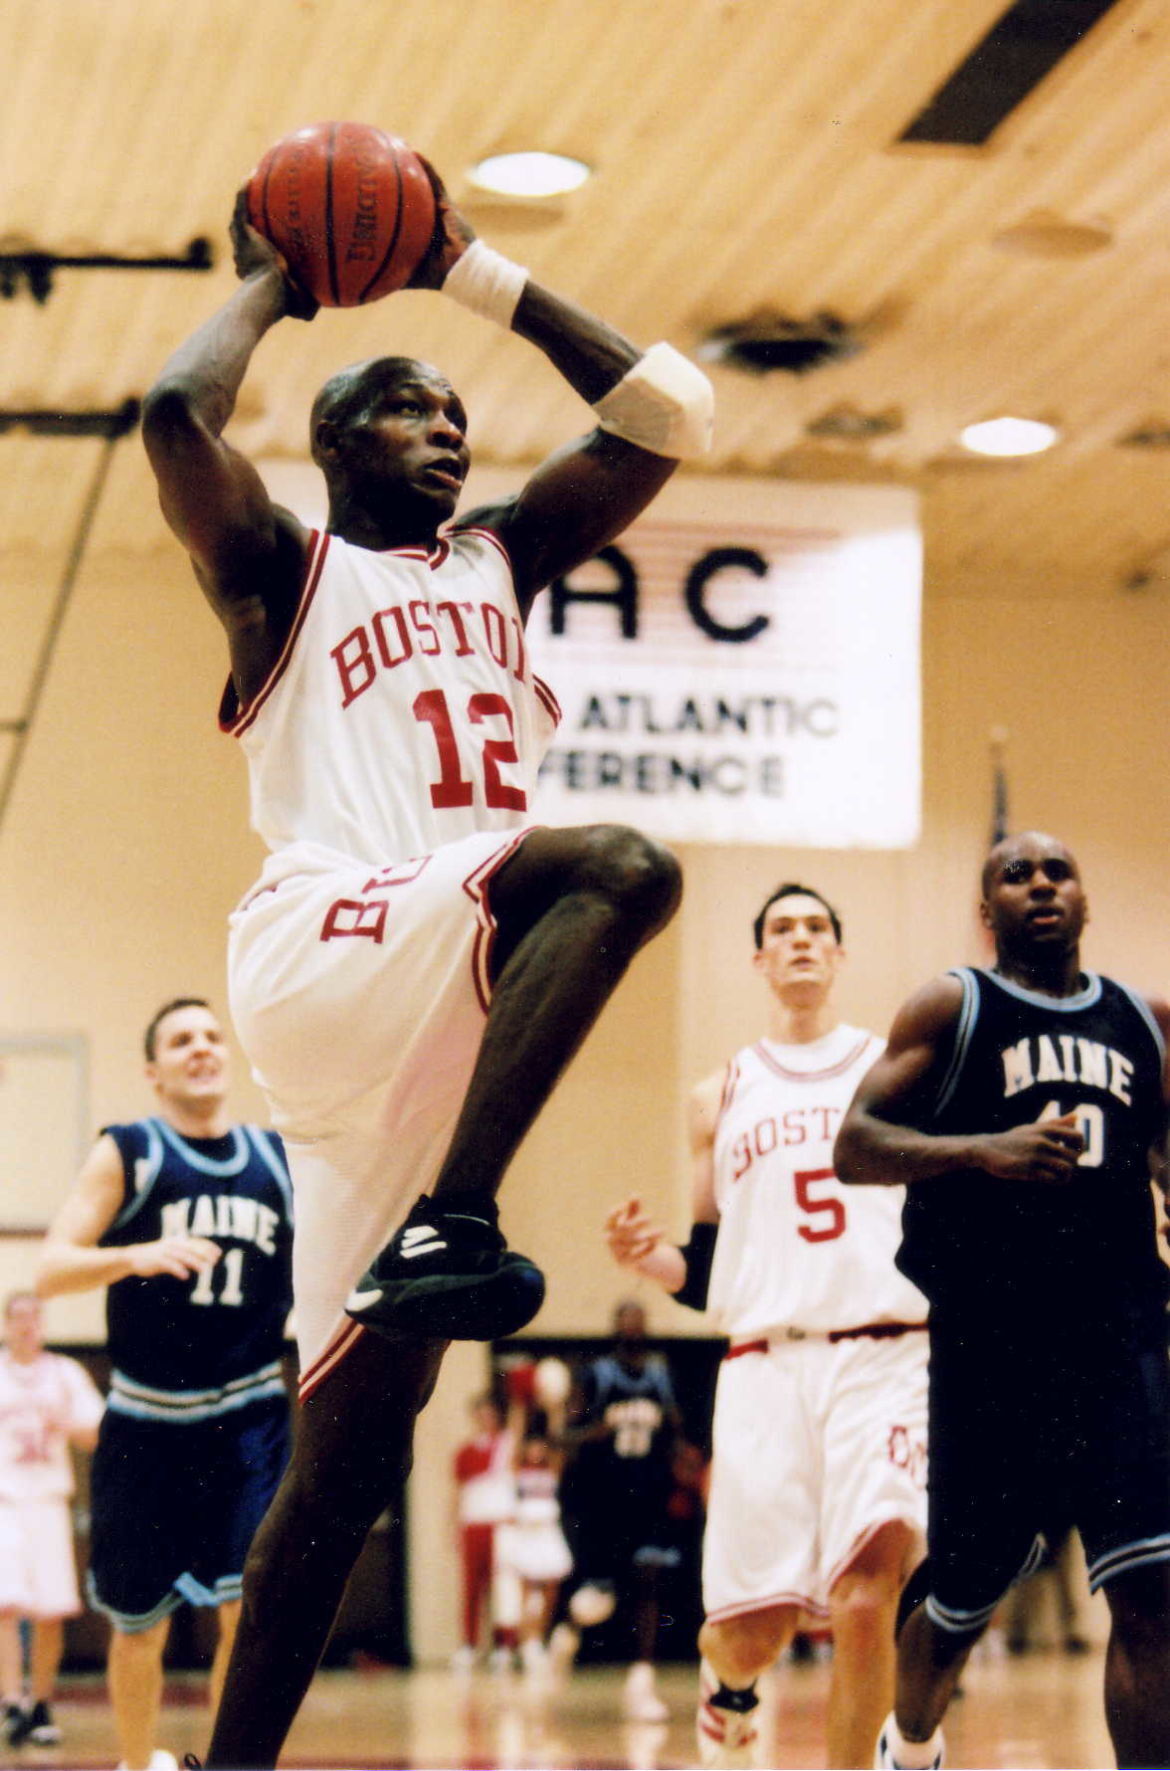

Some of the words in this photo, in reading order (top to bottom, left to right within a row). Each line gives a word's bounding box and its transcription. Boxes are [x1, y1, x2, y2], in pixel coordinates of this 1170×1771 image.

[412, 688, 527, 812] 12
[580, 694, 840, 739] ATLANTIC
[1002, 1034, 1135, 1107] MAINE
[160, 1194, 280, 1257] MAINE
[794, 1167, 846, 1243] 5
